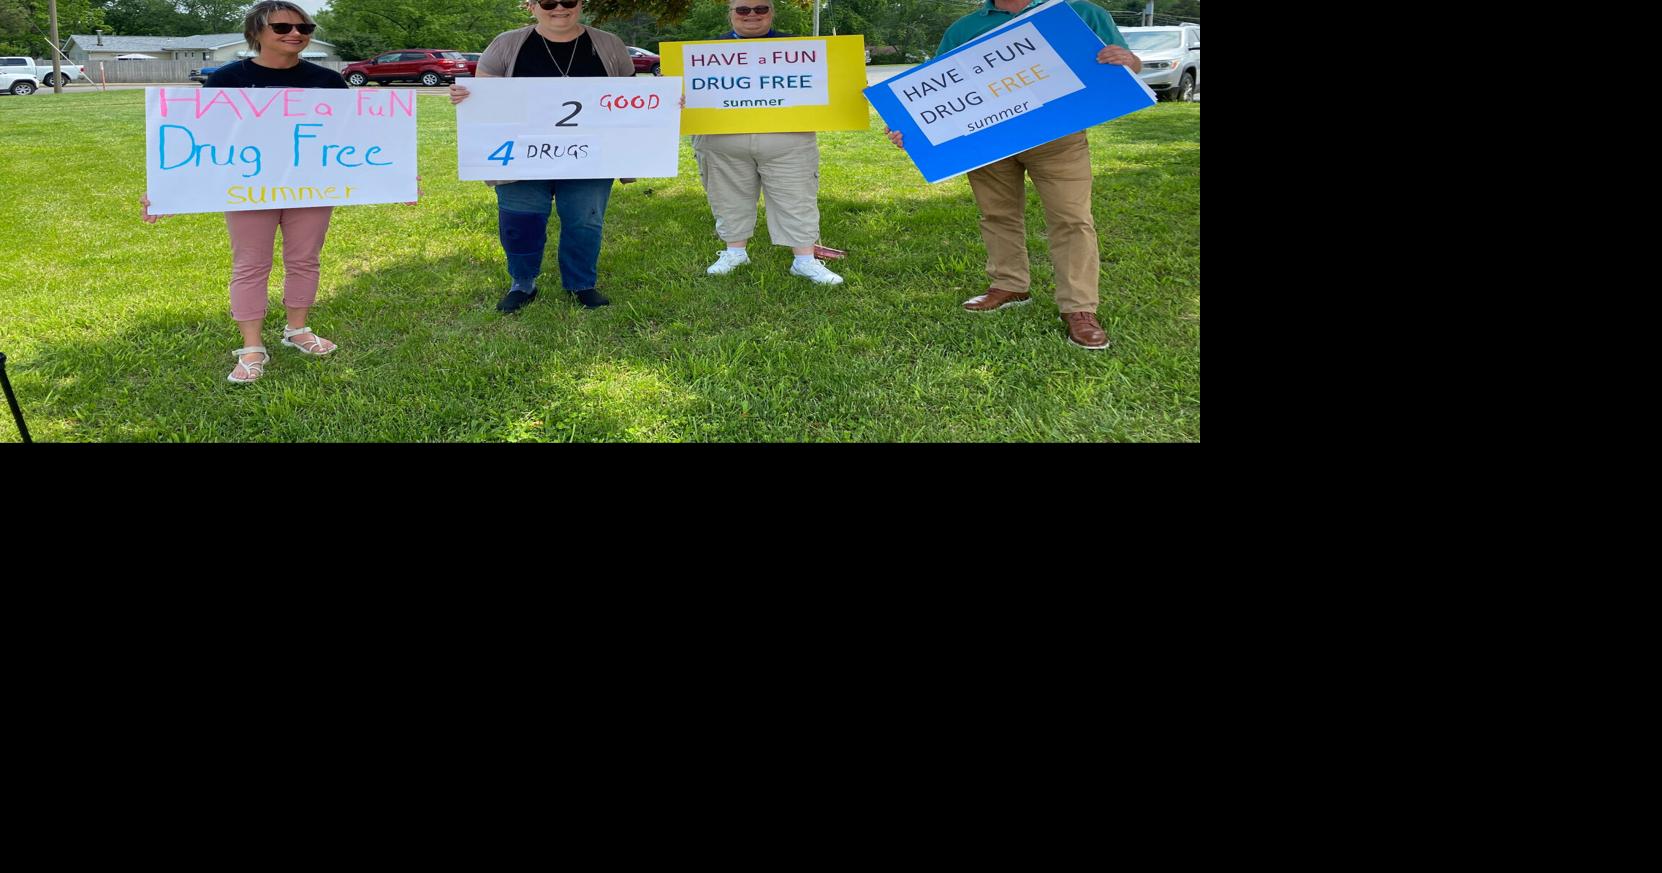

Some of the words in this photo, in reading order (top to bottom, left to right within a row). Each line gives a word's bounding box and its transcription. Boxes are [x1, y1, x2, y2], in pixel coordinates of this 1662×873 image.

[691, 52, 748, 67] HAVE
[758, 55, 766, 65] a
[772, 50, 816, 64] FUN
[903, 67, 964, 103] HAVE
[973, 63, 984, 74] a
[983, 37, 1036, 69] FUN
[692, 76, 751, 90] DRUG
[760, 74, 812, 89] FREE
[920, 91, 983, 125] DRUG
[987, 63, 1050, 98] FREE
[160, 88, 306, 120] HAVE
[315, 102, 333, 116] a
[555, 100, 583, 127] 2
[600, 94, 660, 111] GOOD
[723, 98, 784, 108] summer
[967, 100, 1030, 132] summer
[159, 124, 261, 178] Drug
[293, 123, 393, 167] Free
[487, 140, 516, 166] 4
[527, 143, 590, 160] DRUGS
[226, 184, 358, 205] summer
